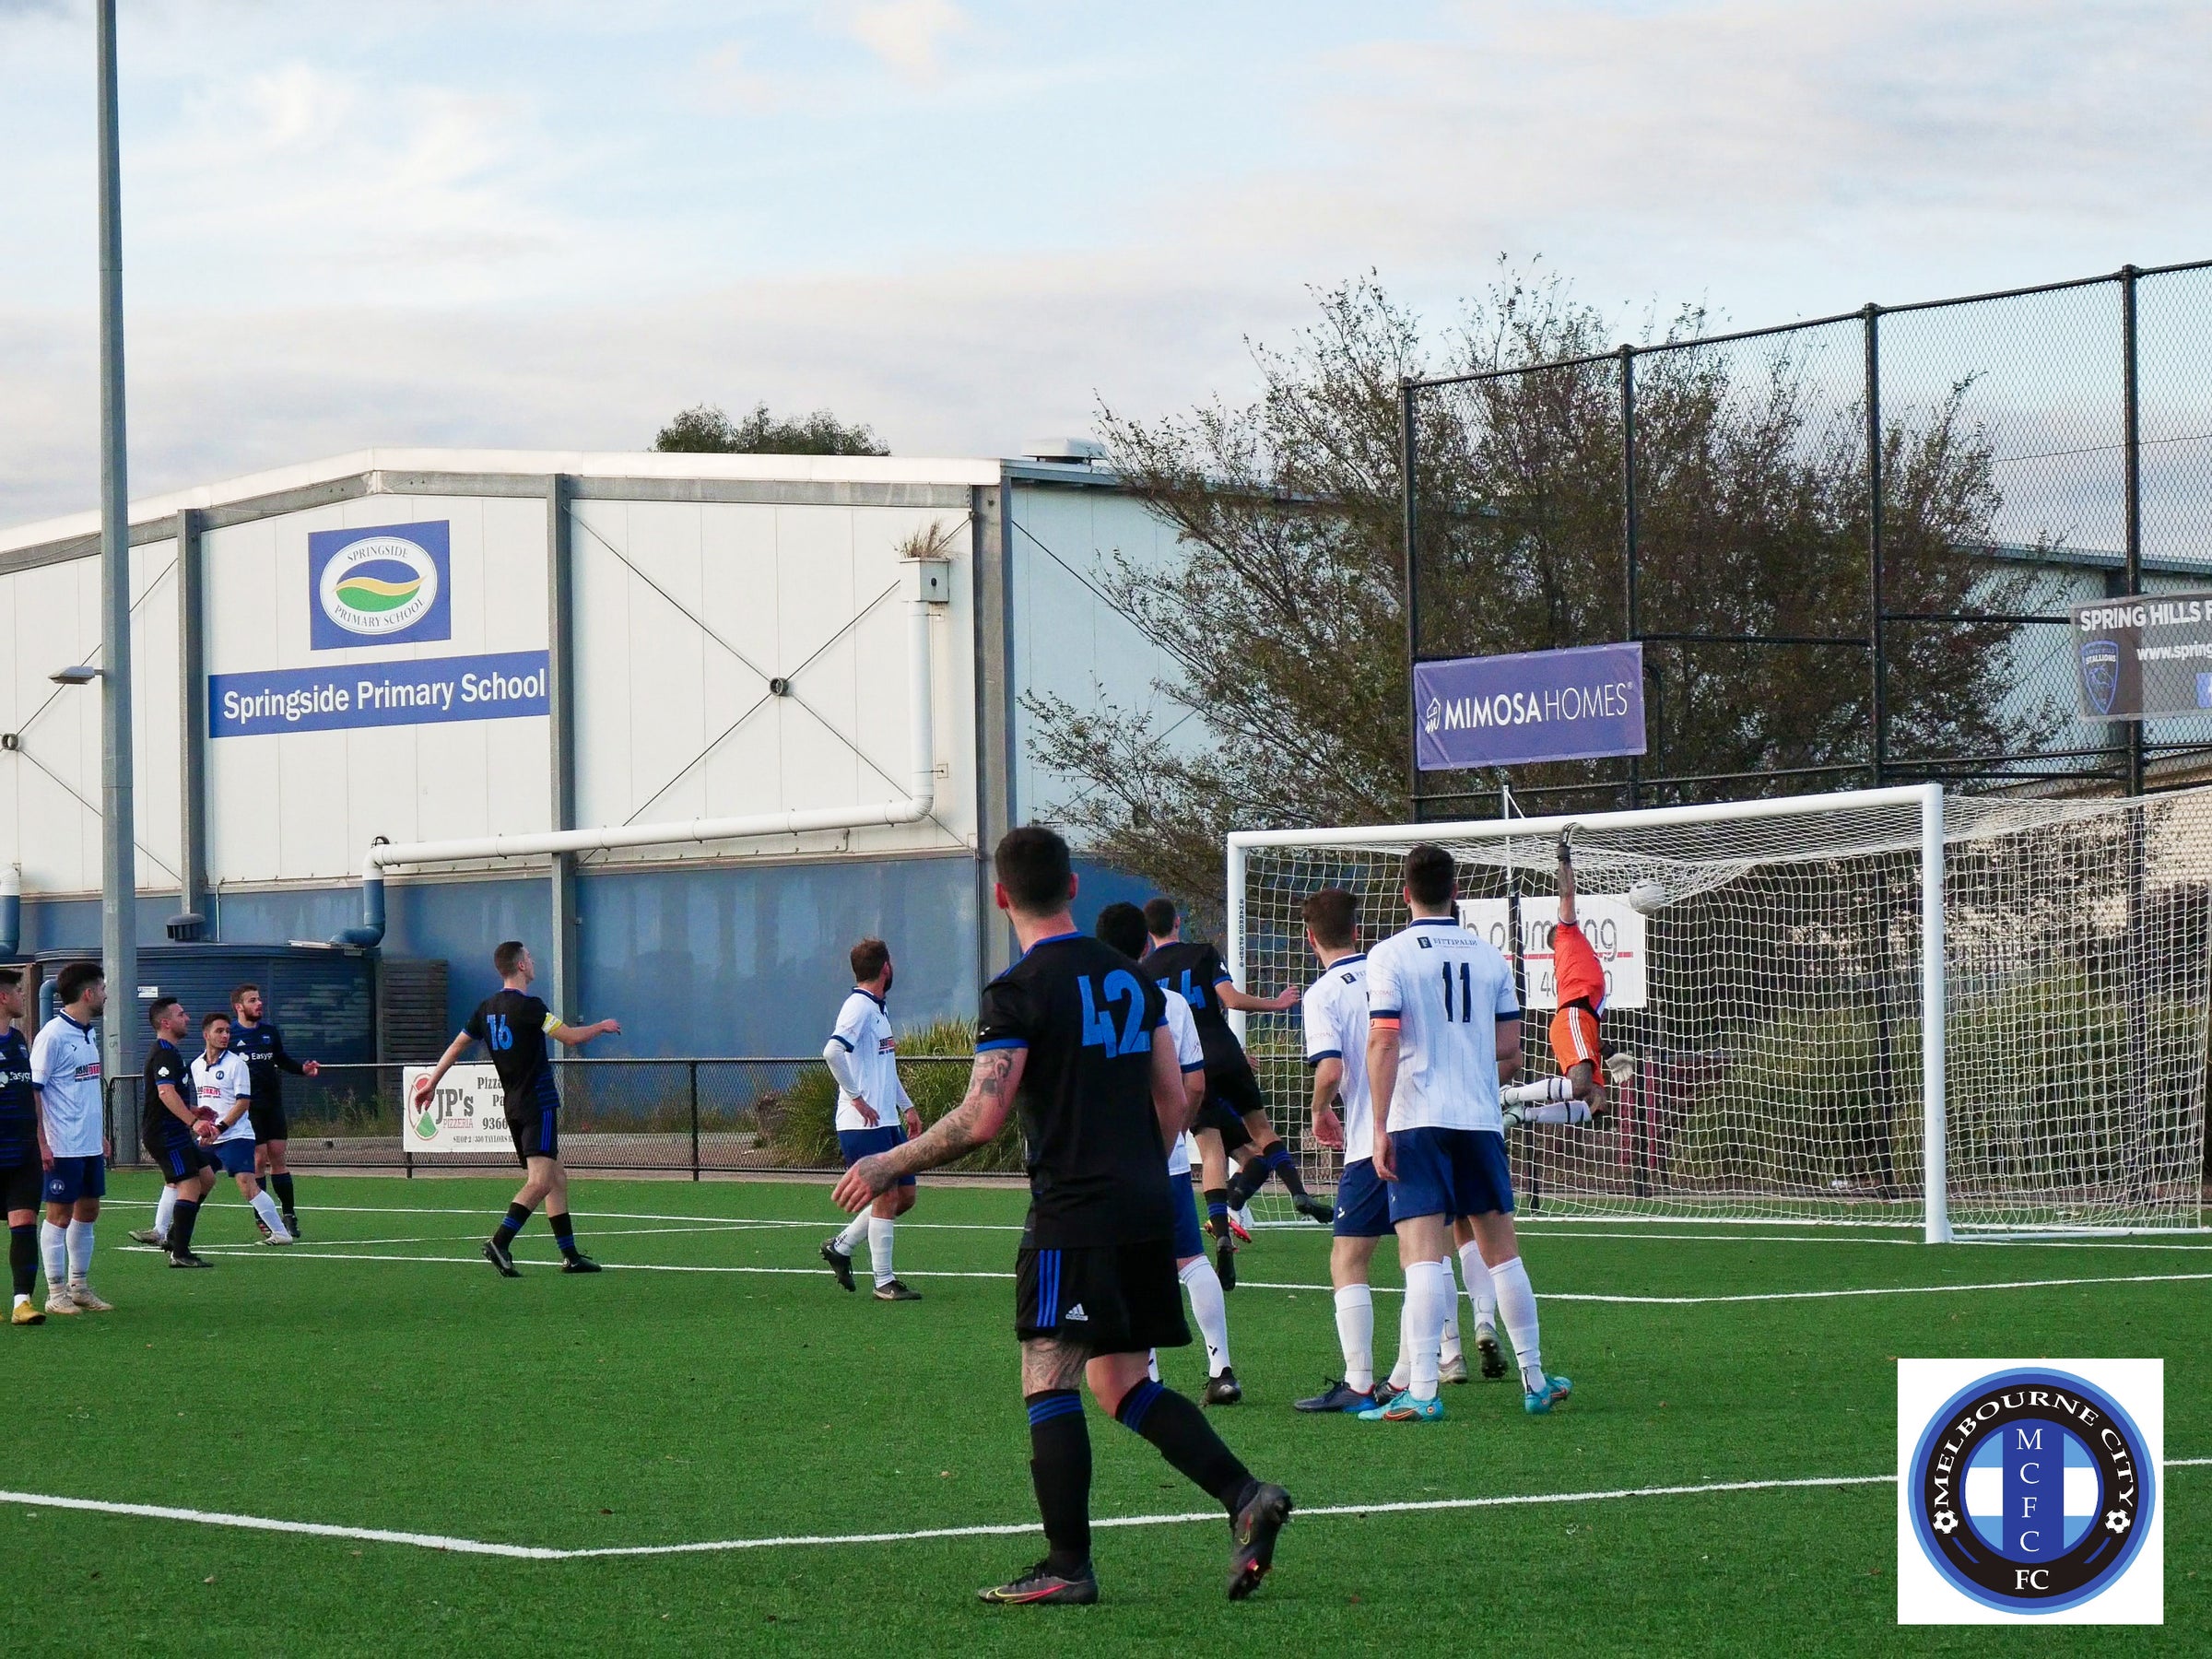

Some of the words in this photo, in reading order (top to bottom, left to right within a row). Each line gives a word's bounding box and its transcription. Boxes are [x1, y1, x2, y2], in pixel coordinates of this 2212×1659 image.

[347, 545, 408, 561] SPRINGSIDE
[335, 605, 381, 627] PRIMARY
[383, 598, 425, 624] SCHOOL
[2080, 606, 2147, 631] SPRING
[2149, 601, 2201, 626] HILLS
[223, 683, 349, 724] Springside
[358, 679, 454, 711] Primary
[461, 667, 546, 702] School
[1444, 691, 1543, 731] MIMOSA
[1442, 961, 1472, 1023] 11
[1077, 969, 1151, 1059] 42
[487, 1014, 513, 1052] 16
[436, 1088, 474, 1124] JP's
[443, 1118, 474, 1129] PIZZERIA
